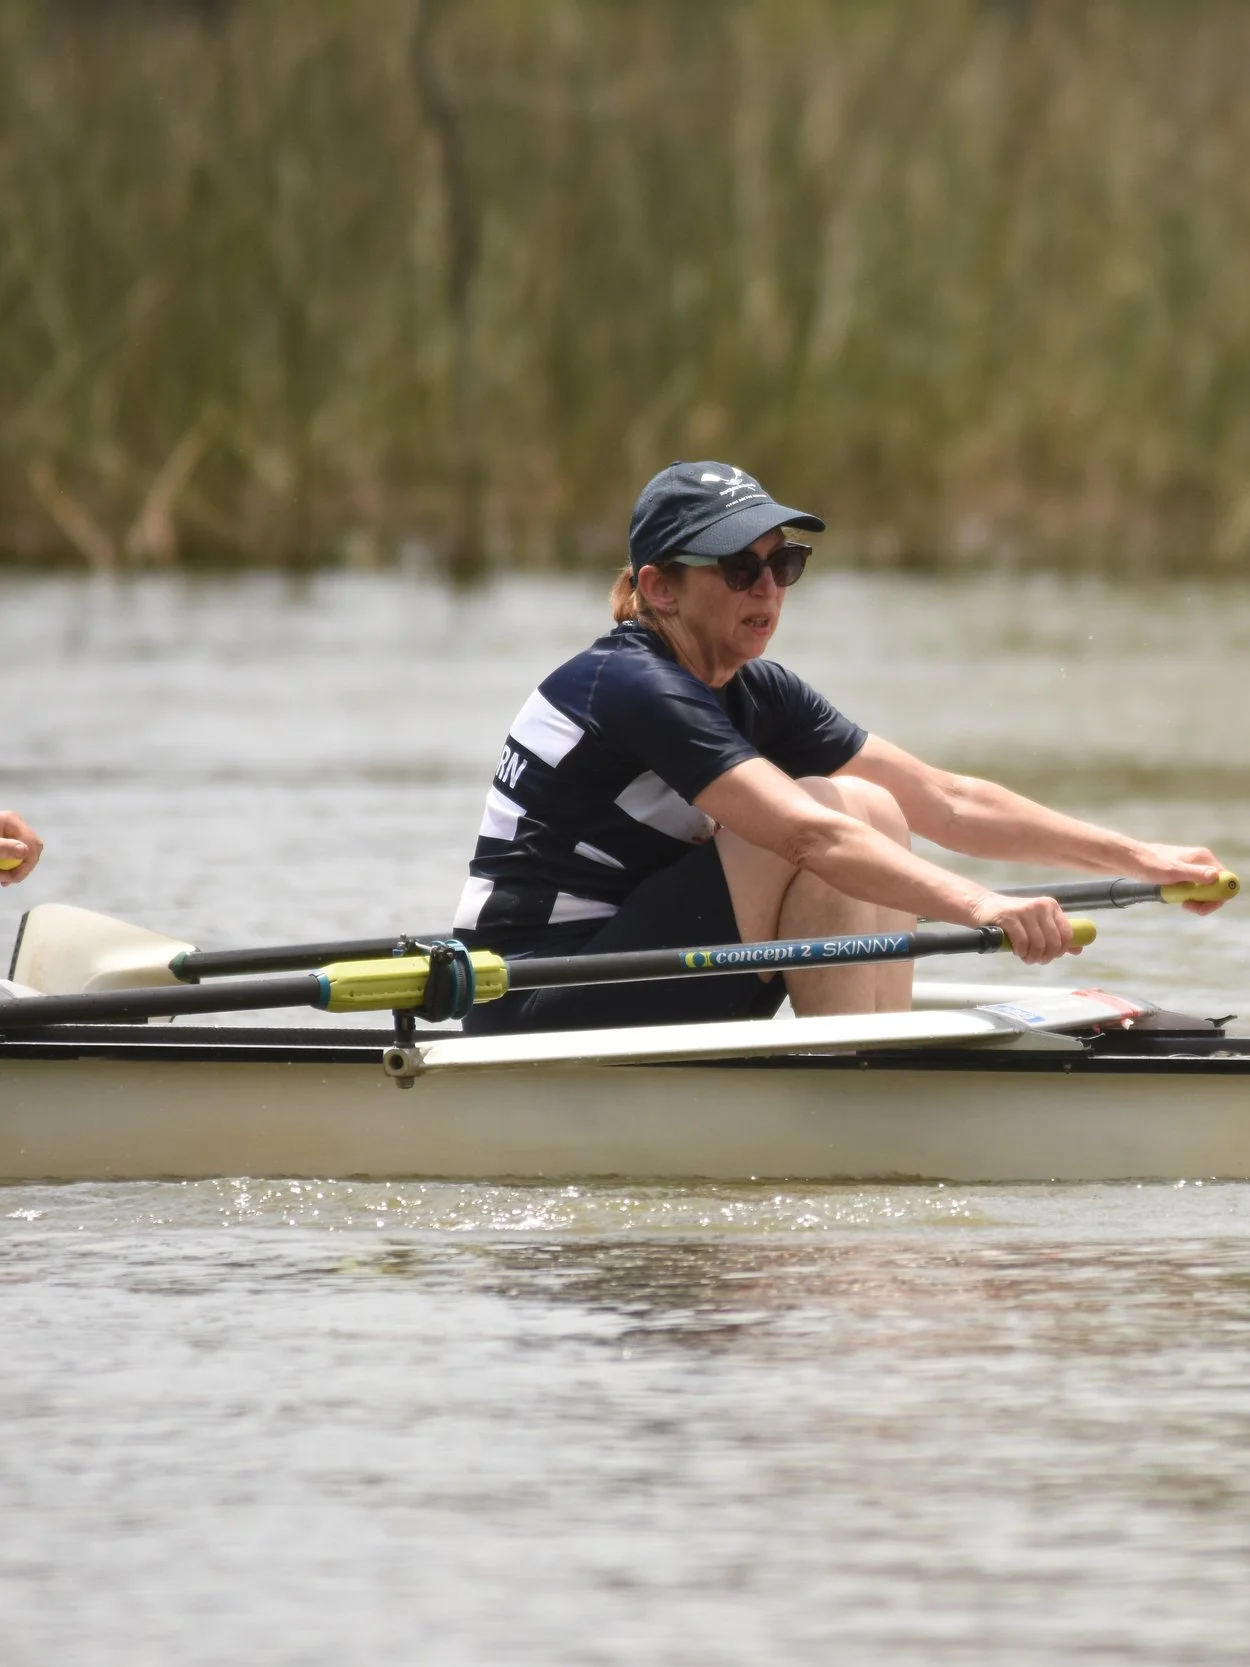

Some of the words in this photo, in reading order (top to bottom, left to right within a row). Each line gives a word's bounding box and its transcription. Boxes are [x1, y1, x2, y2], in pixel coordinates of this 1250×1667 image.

[715, 944, 796, 965] concept
[800, 945, 811, 958] 2
[822, 937, 903, 958] SKINNY
